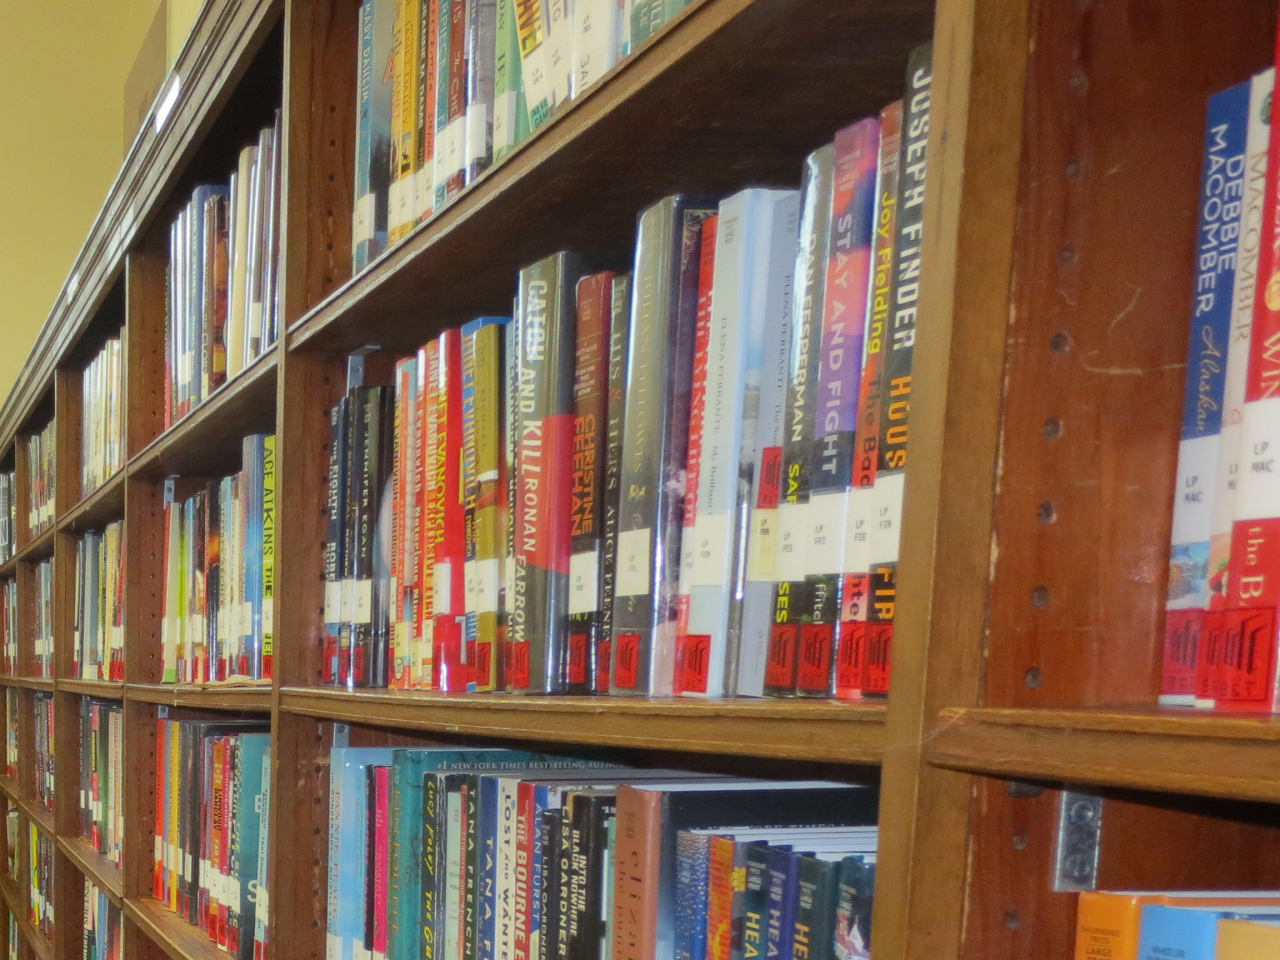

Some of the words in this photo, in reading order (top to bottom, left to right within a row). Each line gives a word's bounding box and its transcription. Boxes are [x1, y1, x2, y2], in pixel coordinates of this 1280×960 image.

[904, 69, 933, 208] JOSEPH
[878, 191, 898, 238] Joy
[1194, 123, 1230, 318] MACOMBER
[1216, 154, 1246, 275] DEBBIE
[804, 234, 818, 286] DAN
[835, 213, 854, 287] STAY
[867, 246, 894, 354] Fielding
[892, 222, 923, 351] FINDER
[525, 279, 548, 364] CATCH
[828, 299, 846, 370] AND
[521, 367, 537, 414] AND
[790, 304, 815, 443] FESPERMAN
[1193, 324, 1221, 435] Alaskan
[521, 419, 544, 476] KILL
[606, 417, 620, 488] HERS
[820, 379, 841, 475] FIGHT
[570, 416, 585, 538] FEEHAN
[582, 413, 597, 535] CHRISTINE
[1183, 492, 1205, 505] MAC
[1251, 459, 1277, 473] MAC
[262, 487, 276, 557] ATKINS
[360, 514, 369, 559] EGAN
[522, 477, 539, 553] RONAN
[604, 504, 617, 566] ALICE
[514, 554, 527, 643] FARROW
[426, 781, 436, 819] LUCY
[467, 788, 476, 852] TANA
[503, 793, 512, 849] LOST
[516, 815, 526, 844] THE
[533, 801, 543, 854] ALAN
[560, 804, 570, 851] LISA
[423, 824, 435, 876] FOLEY
[483, 836, 494, 921] TANA
[571, 828, 581, 871] BLACK
[577, 853, 588, 884] INTO
[424, 890, 433, 922] THE
[465, 865, 475, 956] FRENCH
[514, 848, 528, 945] BOURNE
[531, 863, 541, 924] FURST
[557, 857, 569, 957] GARDNER
[568, 874, 580, 938] NOWHERE
[576, 888, 587, 912] THE
